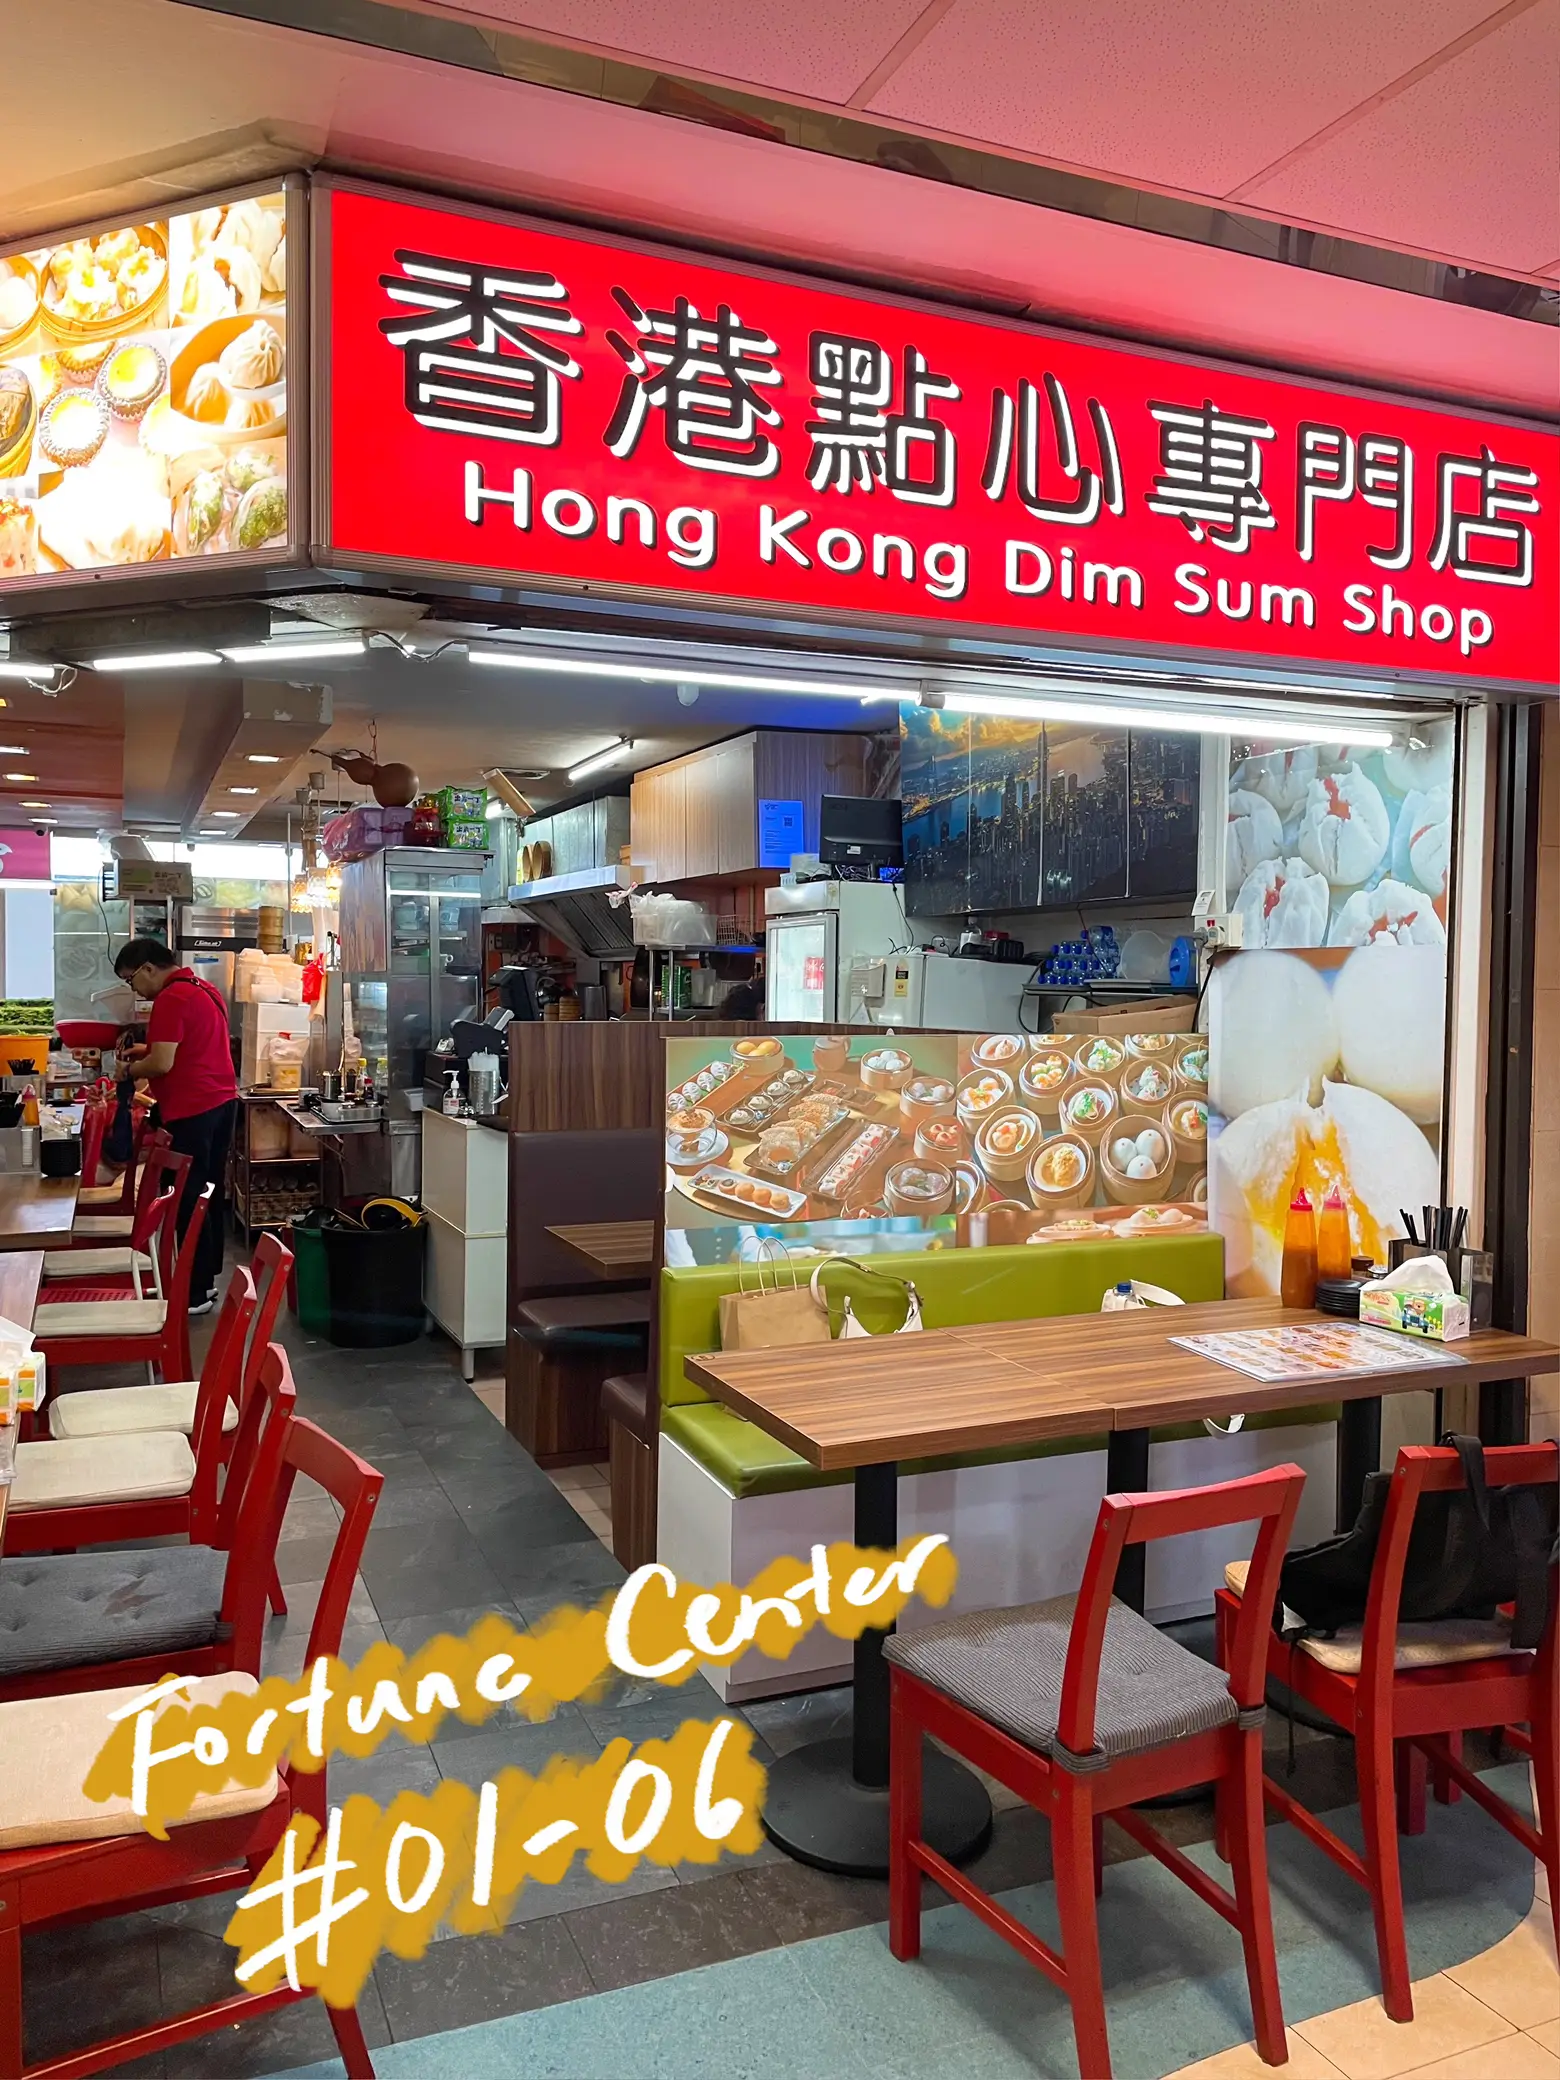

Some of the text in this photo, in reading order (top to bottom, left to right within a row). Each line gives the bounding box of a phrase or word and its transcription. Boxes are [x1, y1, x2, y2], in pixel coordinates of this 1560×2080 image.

[377, 247, 1542, 588] 香港點心專門店
[464, 460, 1494, 657] Hong Kong Dim Sum Shop
